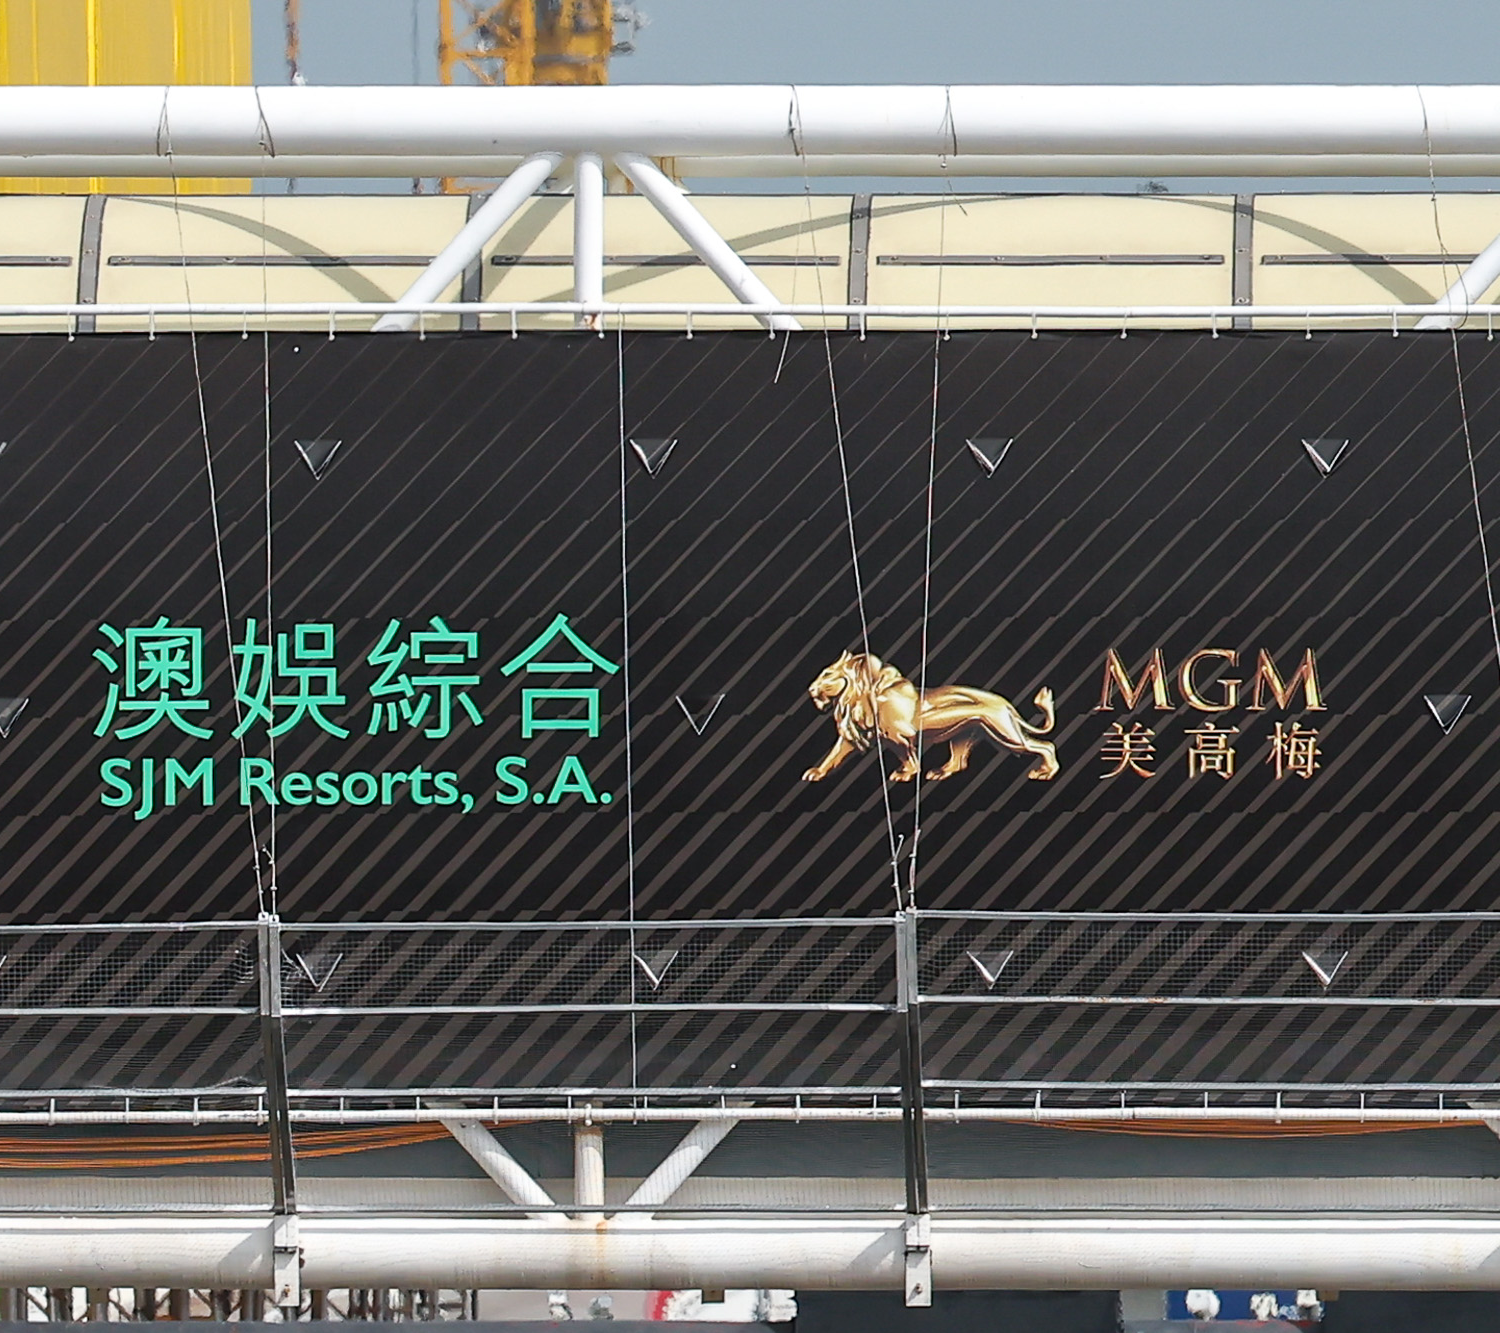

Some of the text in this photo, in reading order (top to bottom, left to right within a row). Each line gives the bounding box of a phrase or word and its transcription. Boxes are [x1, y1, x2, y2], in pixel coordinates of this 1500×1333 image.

[91, 611, 621, 741] 澳娛綜合
[1095, 647, 1328, 712] MGM
[1099, 721, 1323, 780] 美高梅
[99, 755, 613, 820] SJM Resorts, S.A.
